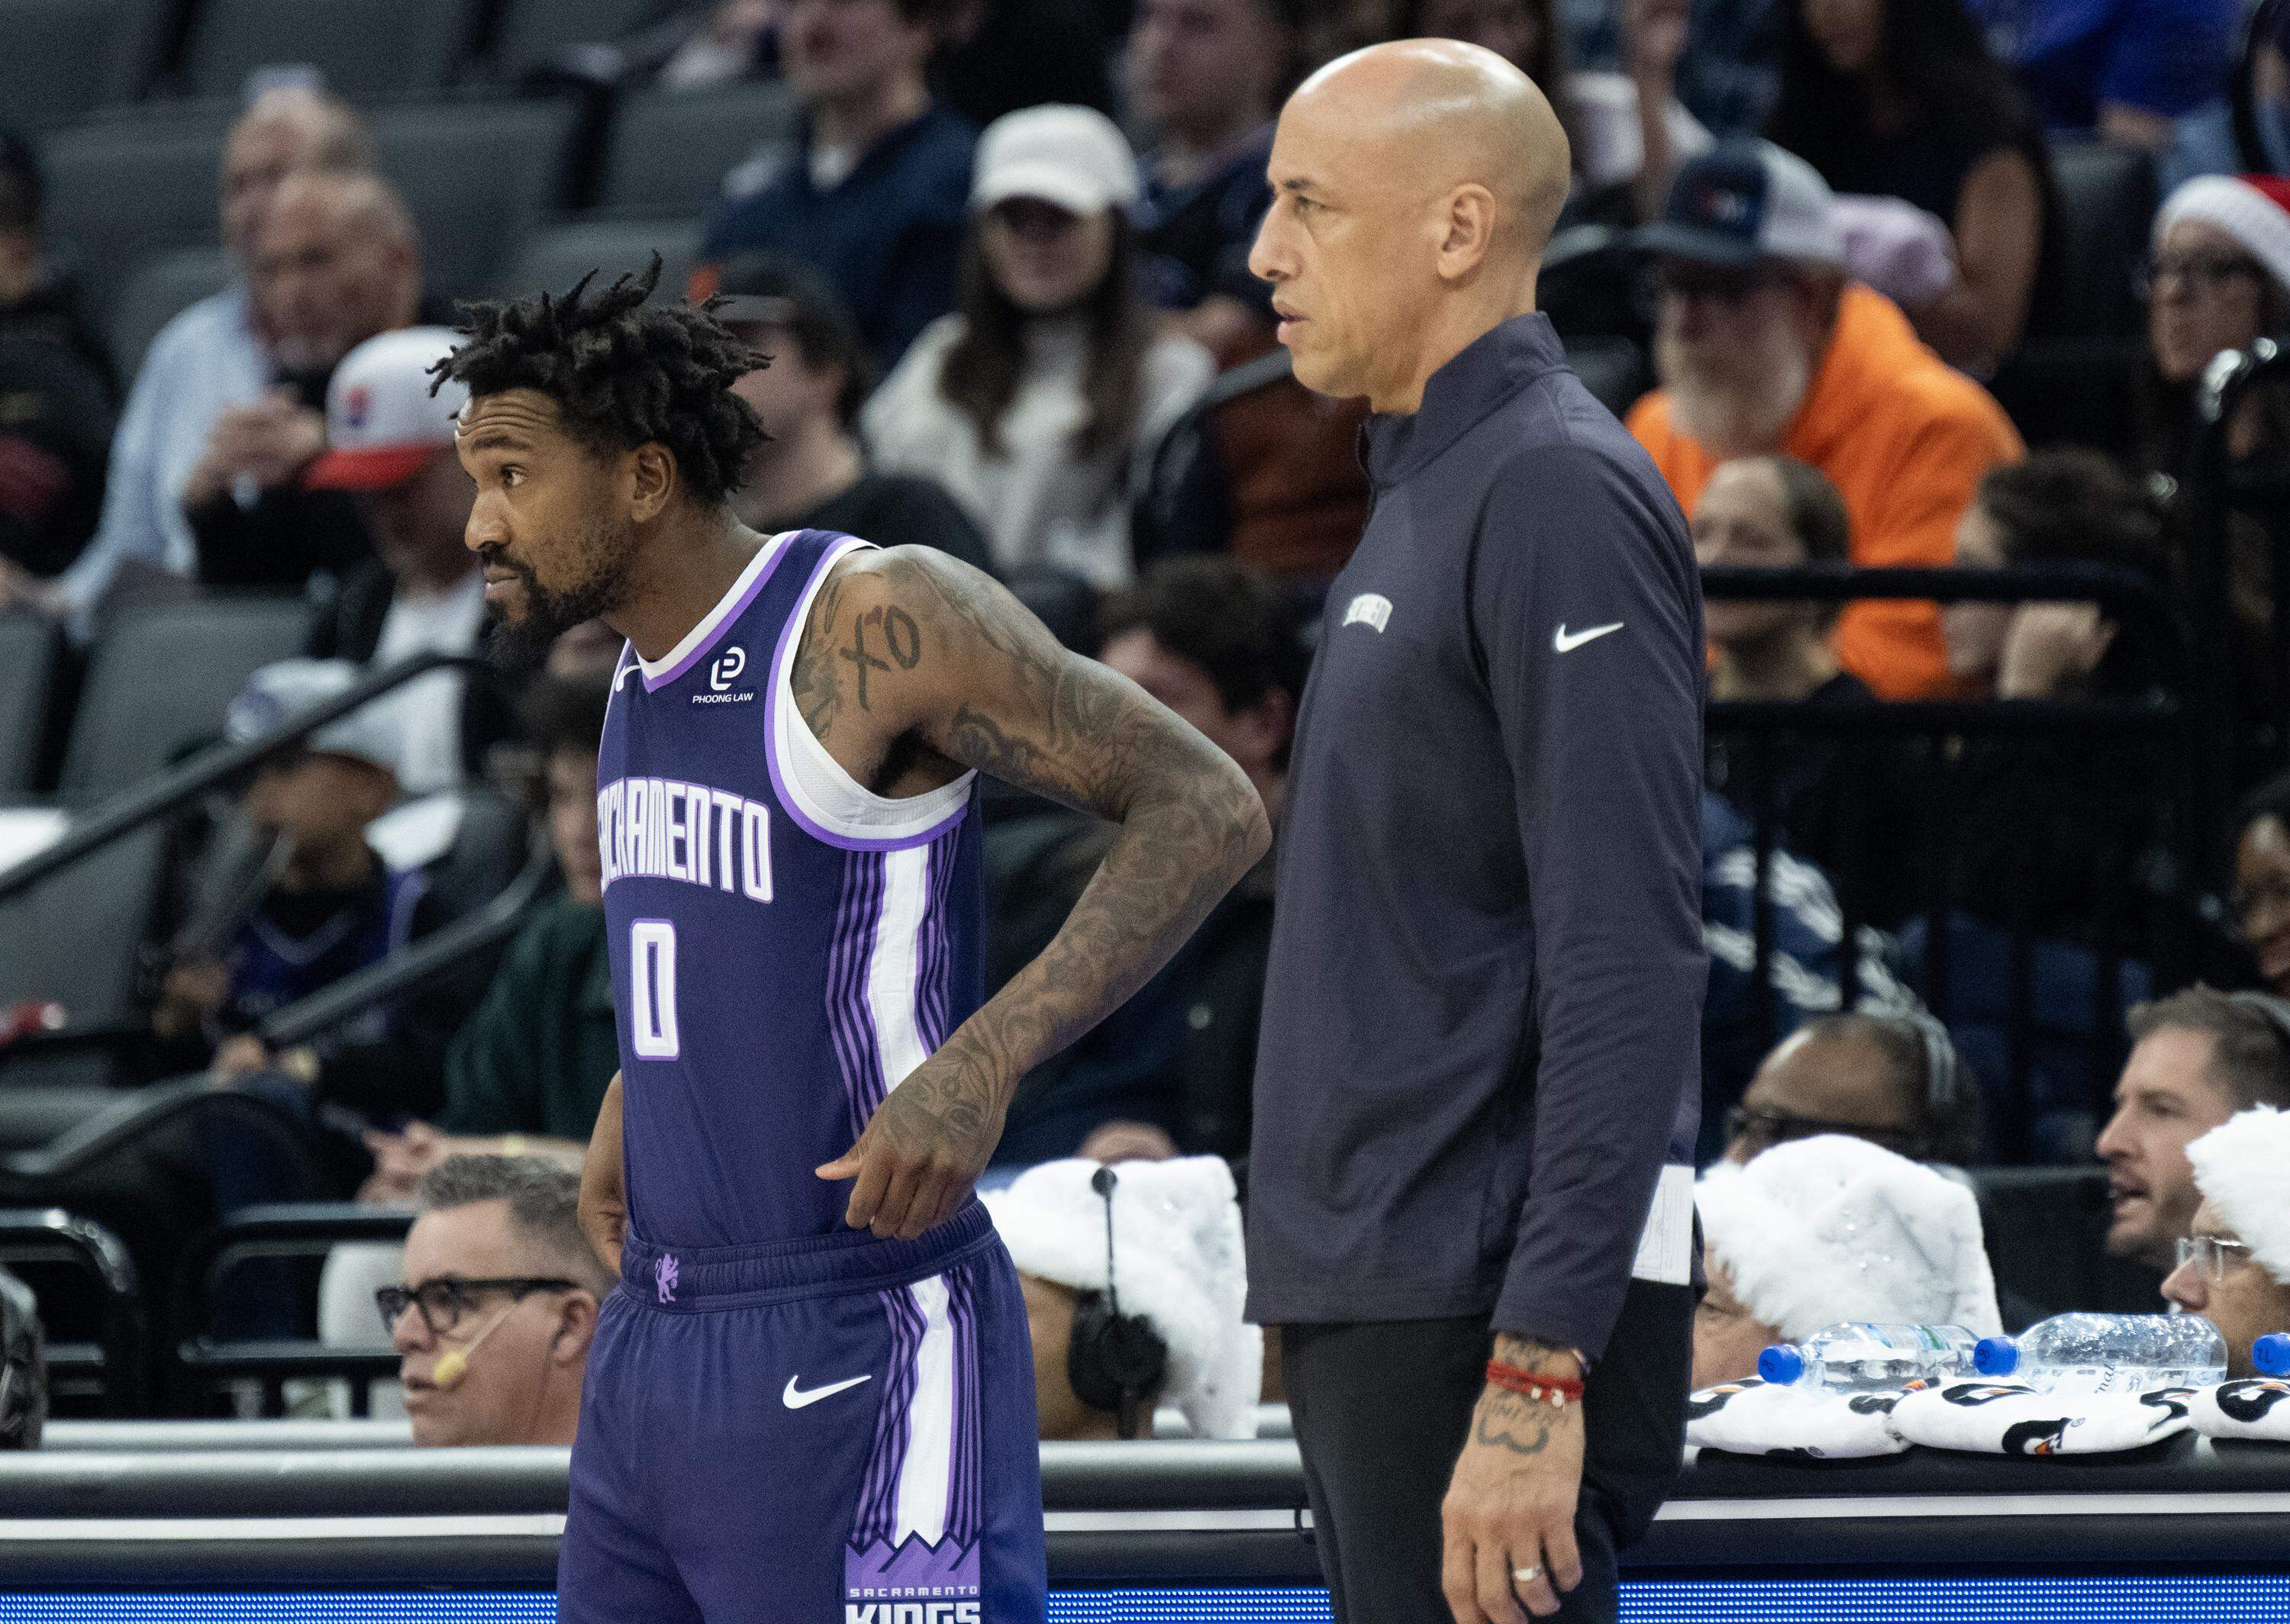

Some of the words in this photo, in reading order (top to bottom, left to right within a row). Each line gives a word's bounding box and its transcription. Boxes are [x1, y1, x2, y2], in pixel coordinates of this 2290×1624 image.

[692, 694, 732, 704] PHOONG
[733, 692, 754, 702] LAW
[630, 918, 680, 1062] 0
[849, 1586, 978, 1597] SACRAMENTO
[845, 1602, 981, 1624] KINGS
